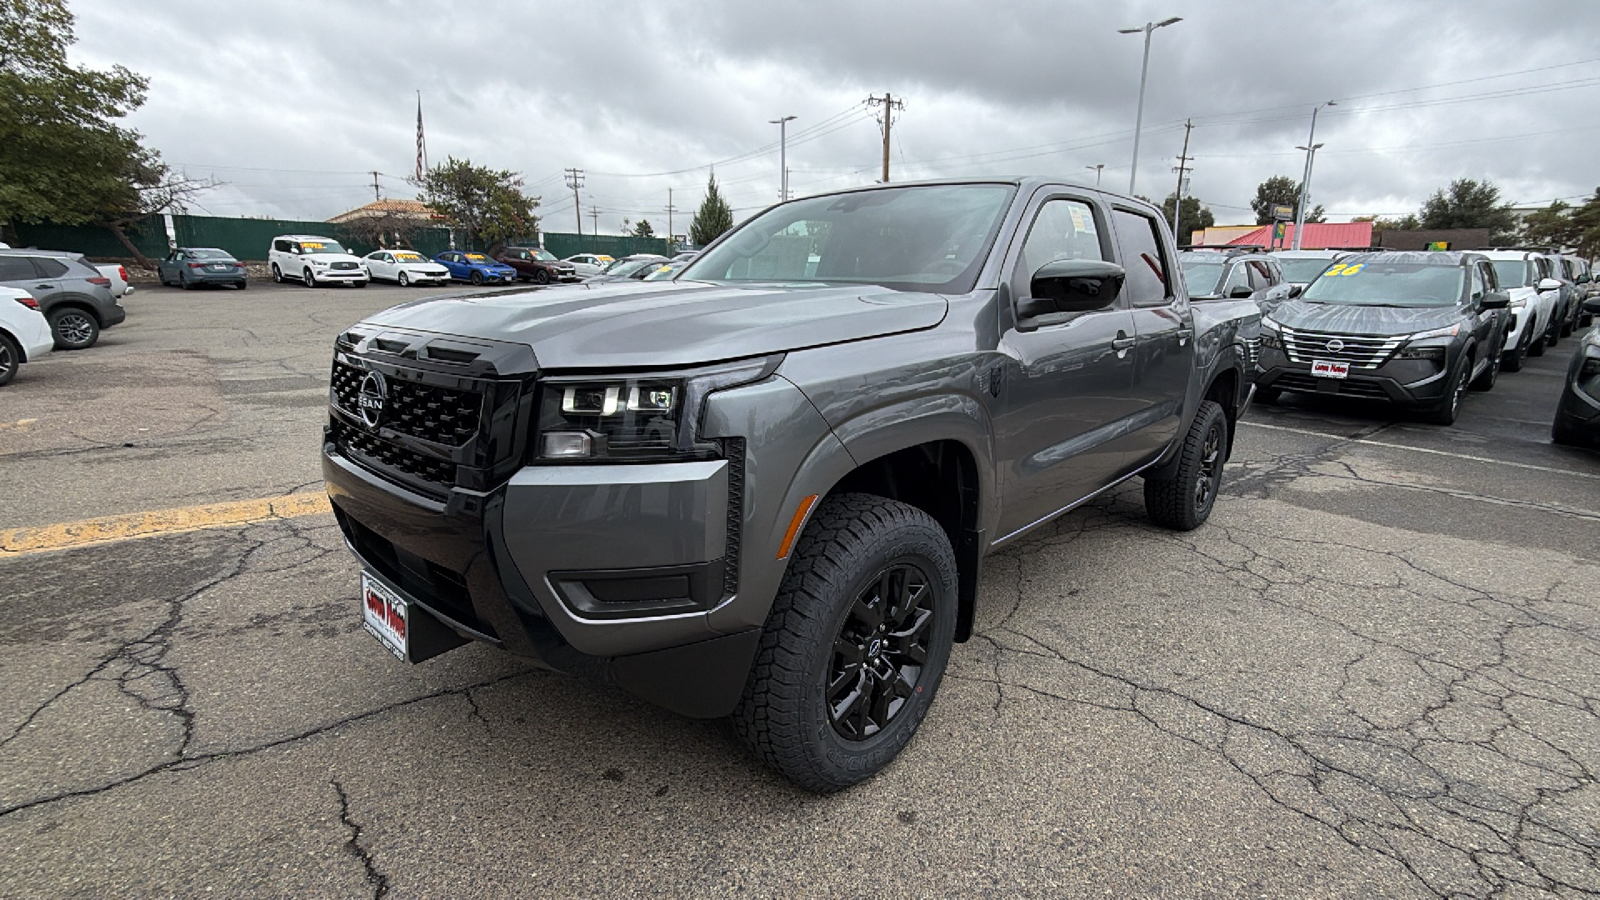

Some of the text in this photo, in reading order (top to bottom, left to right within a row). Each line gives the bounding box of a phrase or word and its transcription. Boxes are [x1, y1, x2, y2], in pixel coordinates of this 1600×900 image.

[1324, 263, 1364, 276] 26
[885, 541, 952, 592] YOKOHAMA
[382, 636, 405, 661] MOTORS
